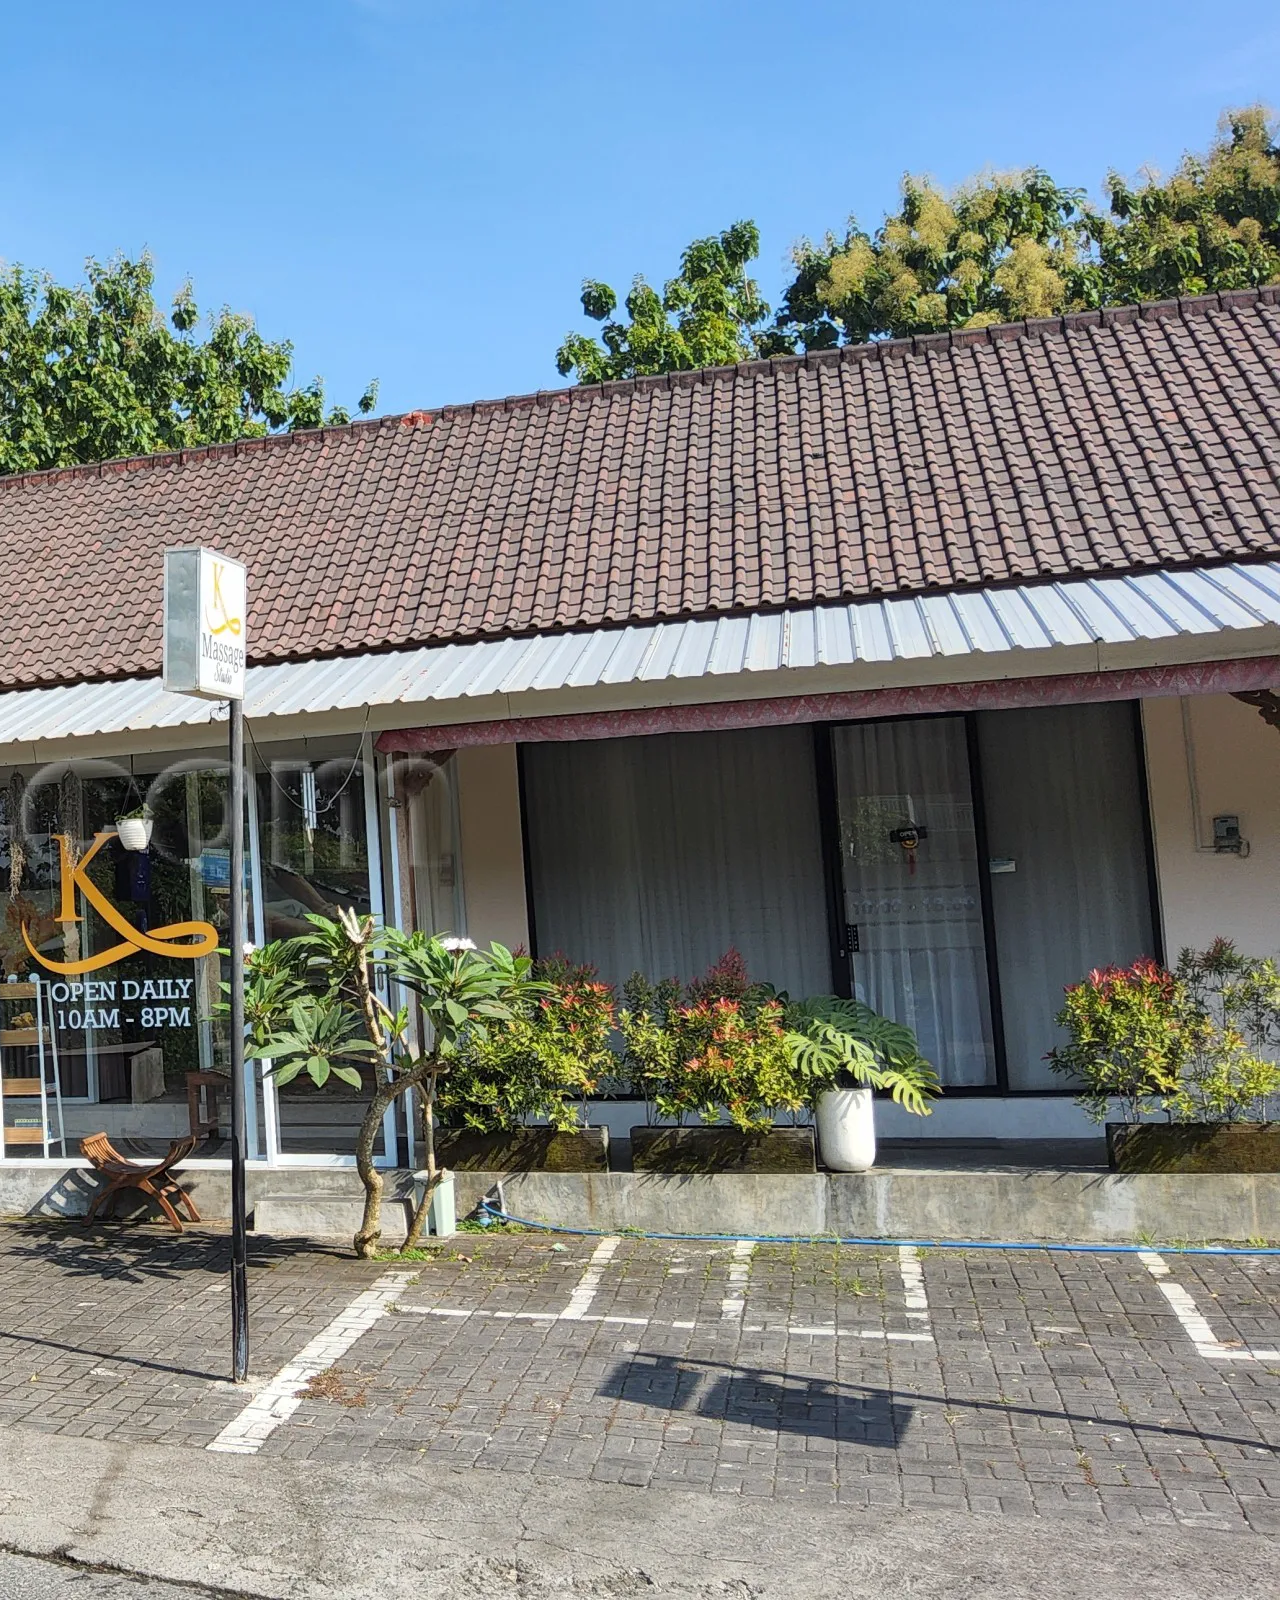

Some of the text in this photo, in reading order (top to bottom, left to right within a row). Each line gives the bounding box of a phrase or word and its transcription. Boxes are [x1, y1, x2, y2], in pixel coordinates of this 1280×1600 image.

[201, 632, 244, 673] Massage
[214, 663, 232, 685] Studio
[21, 831, 219, 975] K
[51, 978, 194, 1003] OPEN DAILY
[57, 1009, 120, 1030] 10AM
[141, 1007, 191, 1028] 8PM
